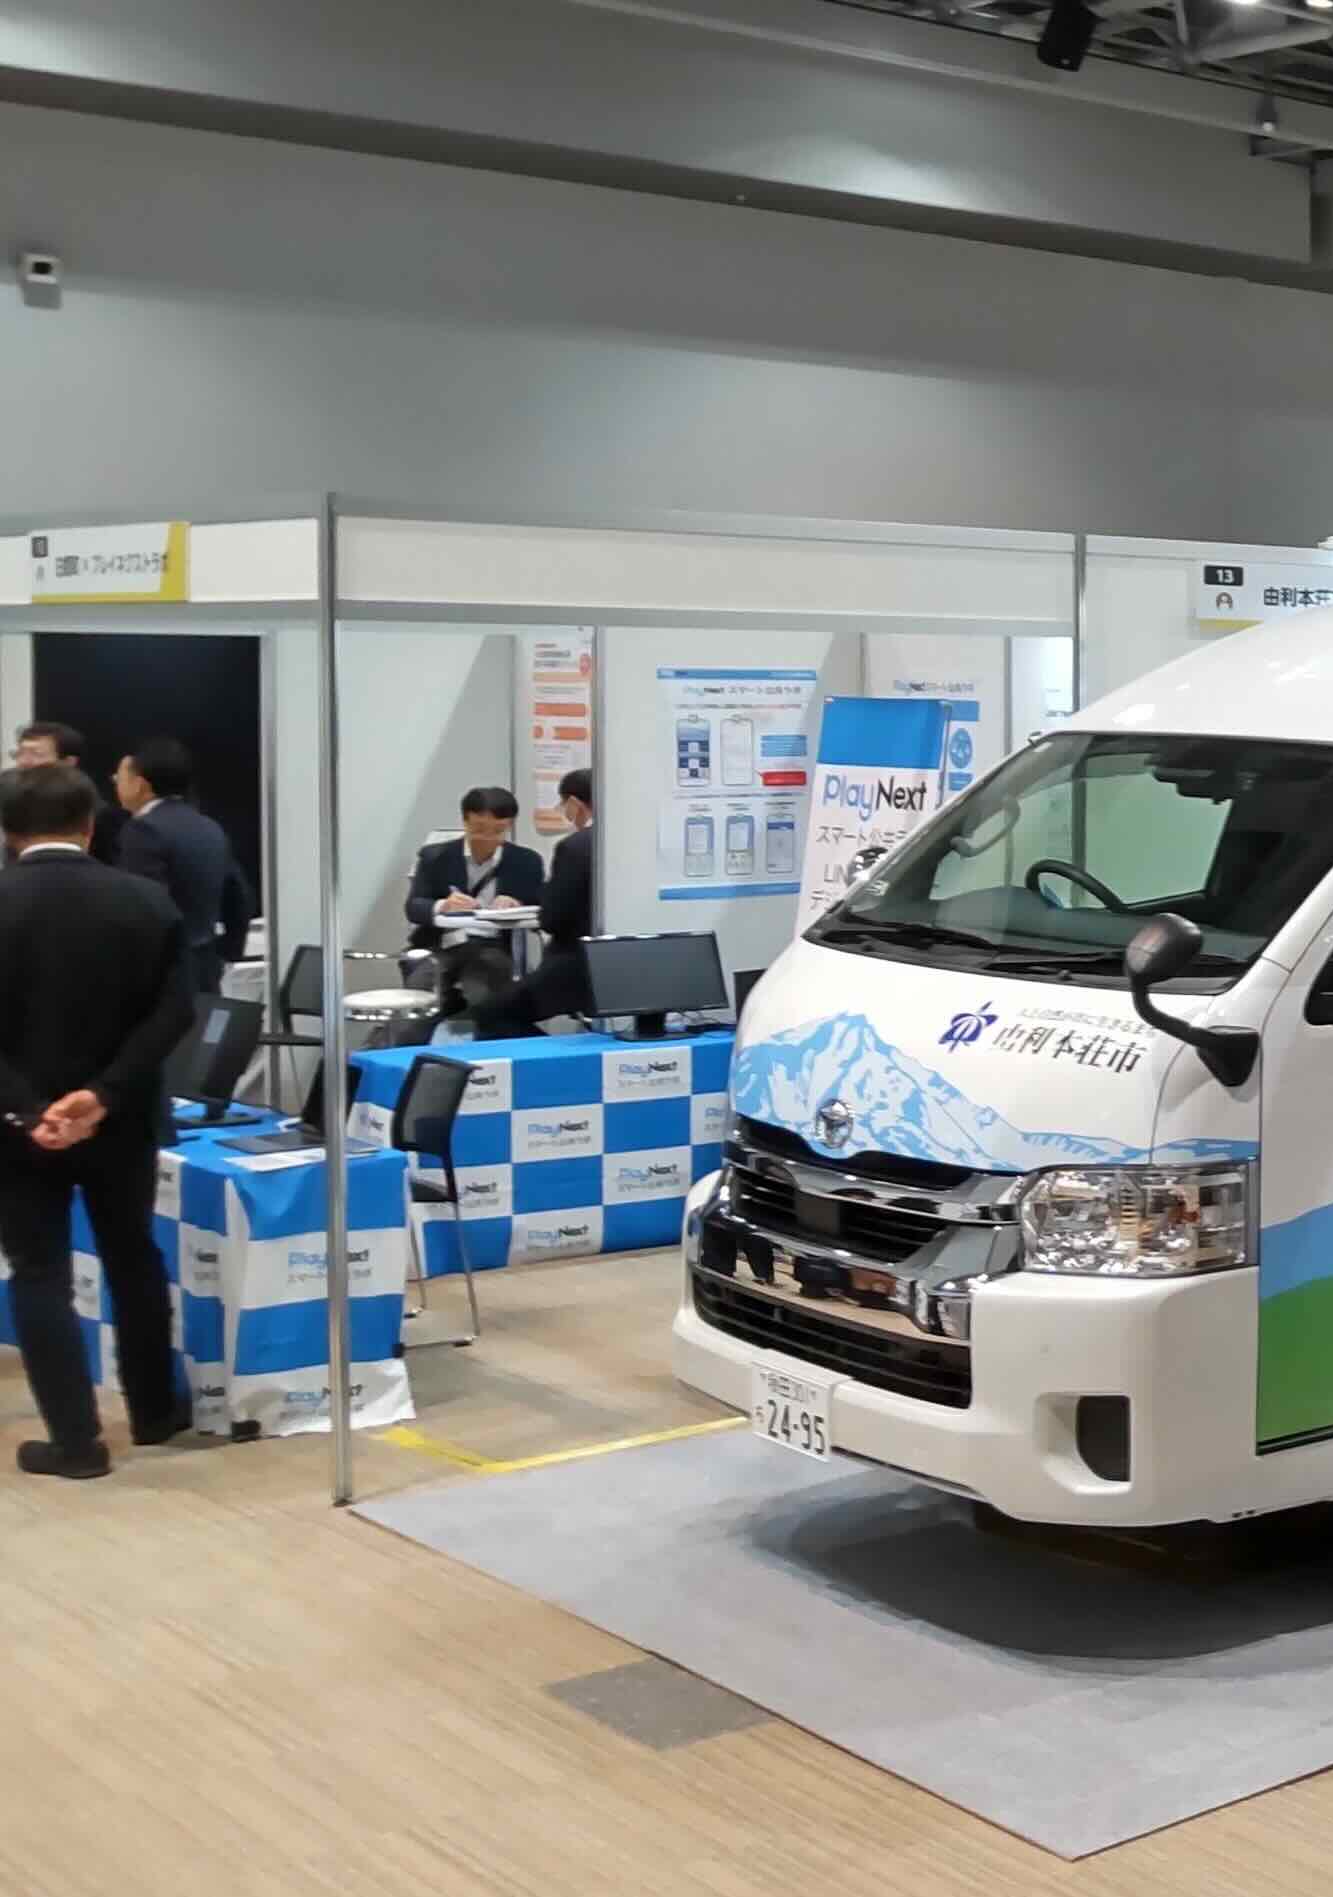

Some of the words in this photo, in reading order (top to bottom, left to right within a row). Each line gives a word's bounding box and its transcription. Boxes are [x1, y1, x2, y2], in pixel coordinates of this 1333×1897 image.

[1215, 569, 1235, 584] 13
[822, 773, 928, 822] PlayNext
[823, 863, 852, 884] LIN
[992, 1022, 1147, 1074] 由利本荘市
[618, 1060, 678, 1078] PlayNext
[767, 1399, 826, 1456] 24-95
